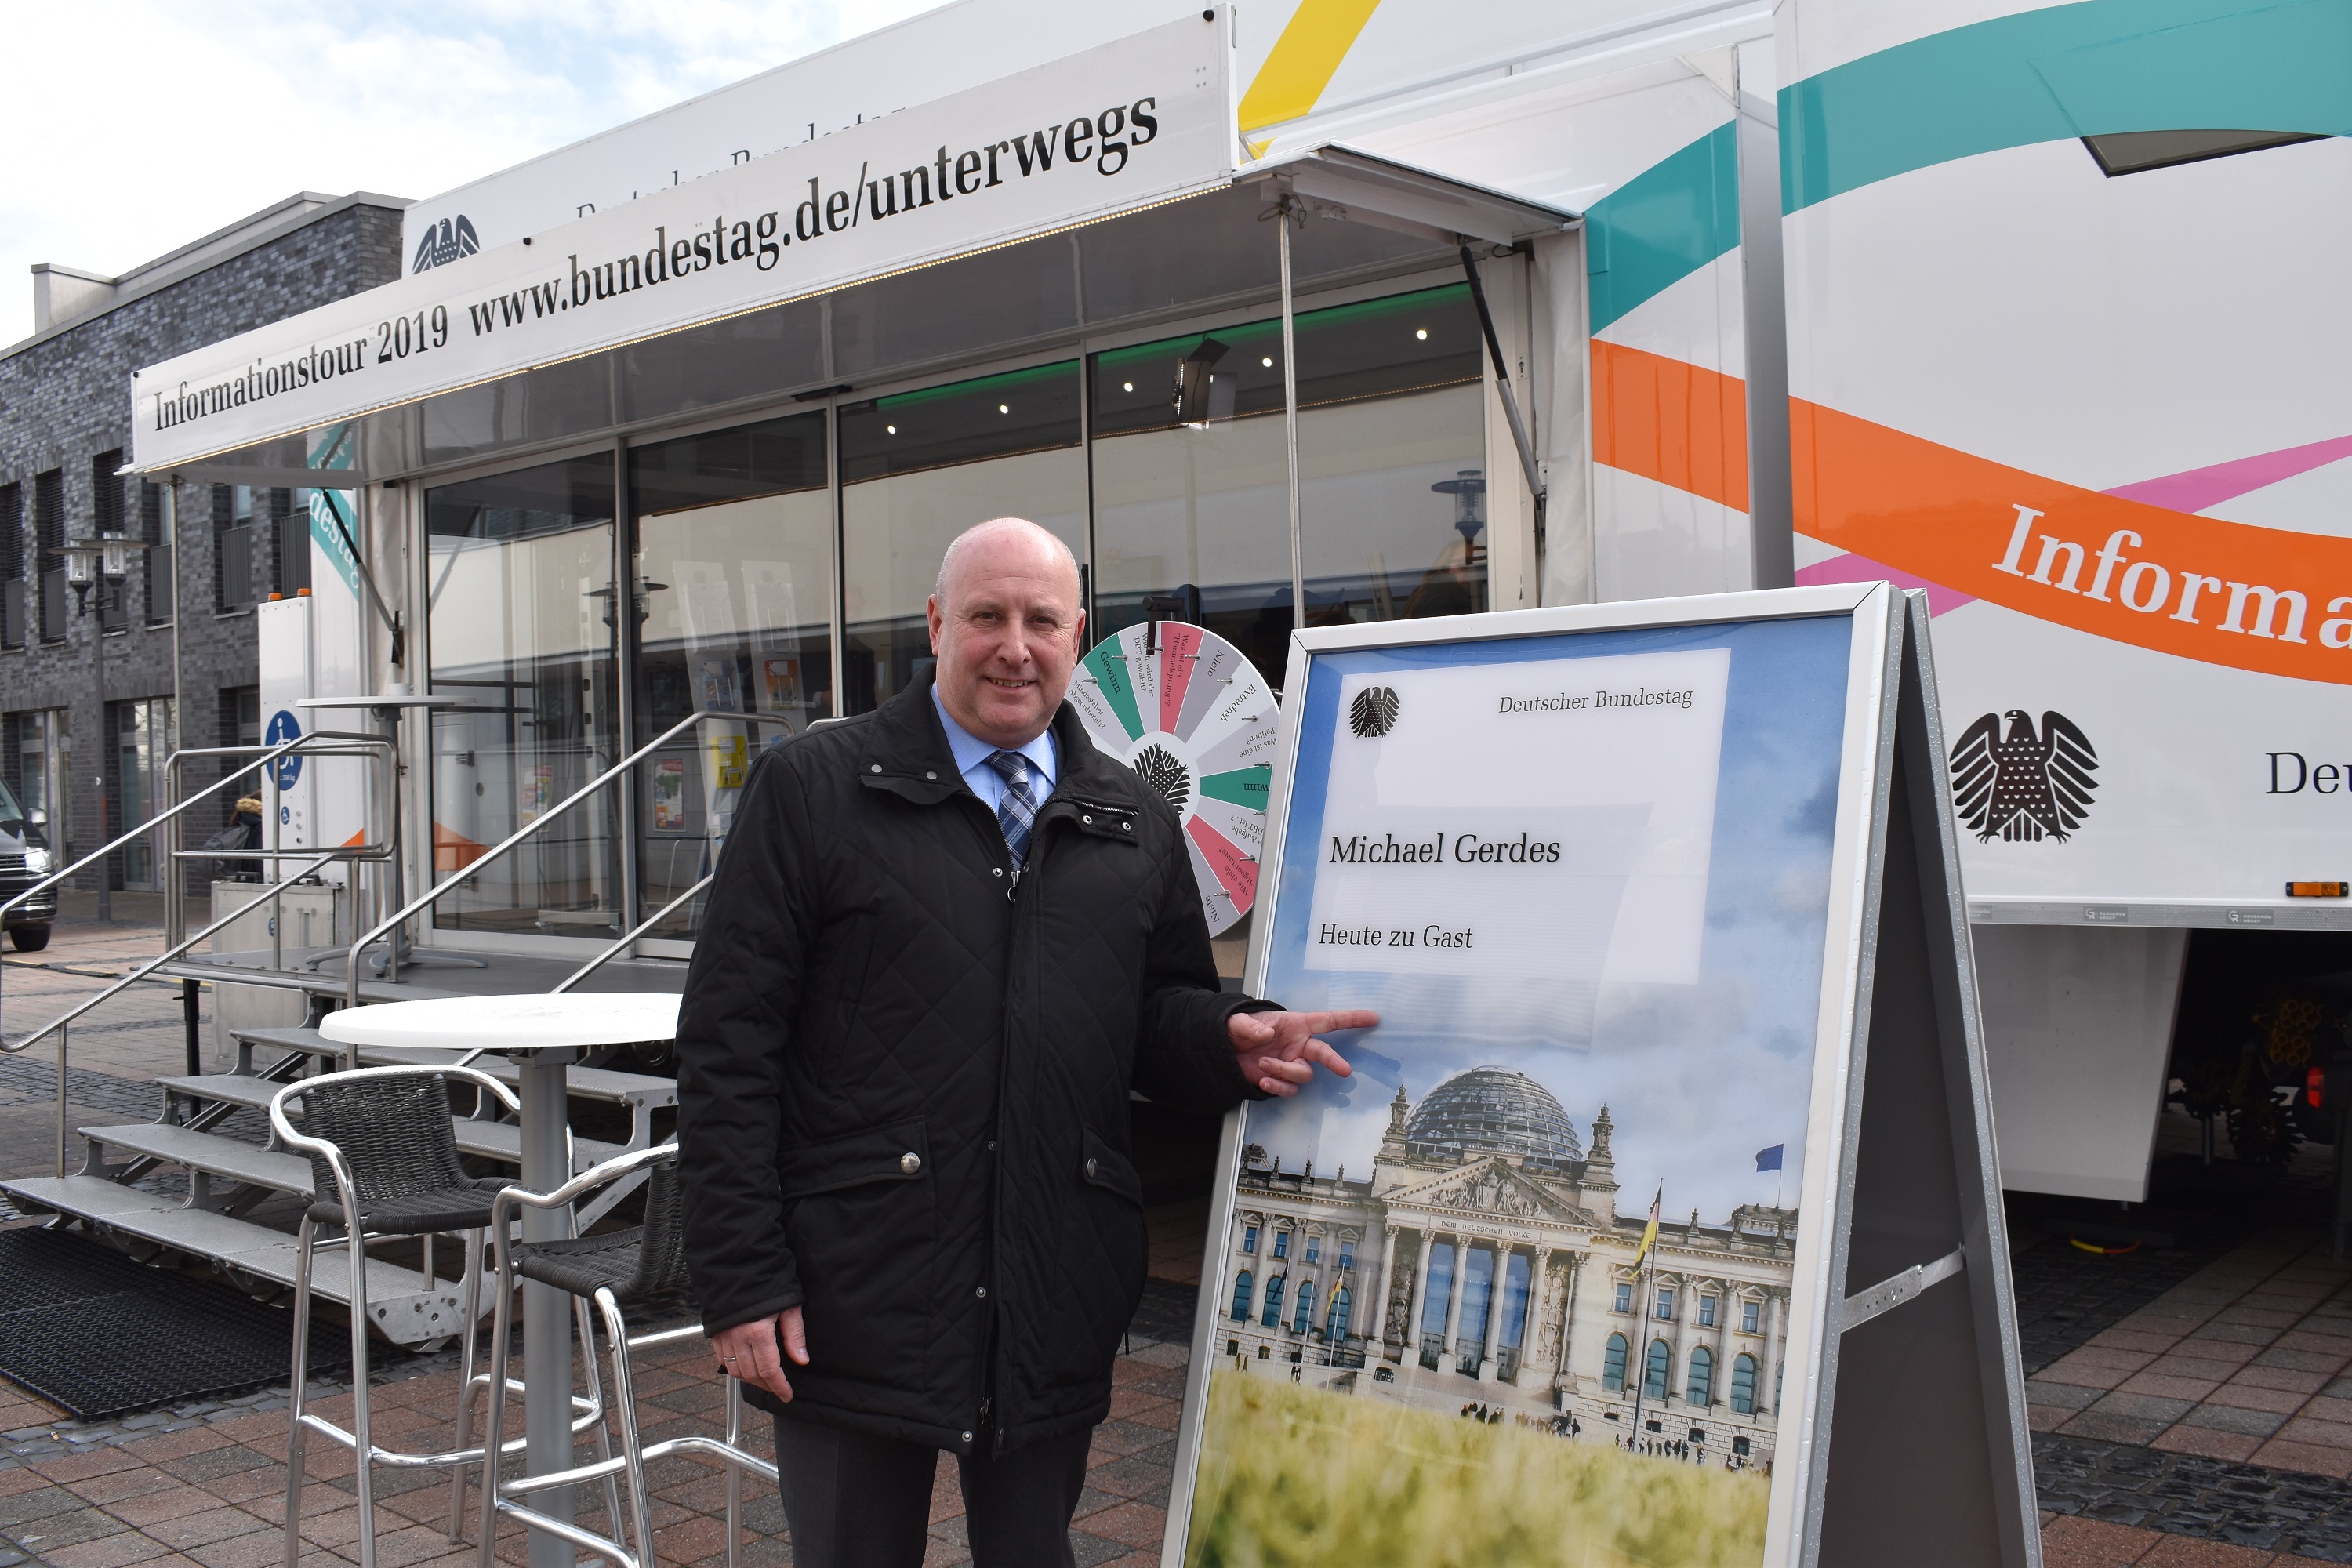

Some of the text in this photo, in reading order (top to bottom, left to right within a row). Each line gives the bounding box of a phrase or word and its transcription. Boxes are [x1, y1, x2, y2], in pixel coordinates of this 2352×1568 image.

[154, 337, 367, 431] Informationstour
[377, 304, 448, 365] 2019
[469, 96, 1160, 338] www.bundestag.de/unterwegs
[1100, 652, 1120, 694] Gewinn
[1136, 657, 1147, 691] gewählt?
[1207, 650, 1225, 677] Niete
[1069, 688, 1105, 730] Abgeordnete/r?
[1073, 680, 1104, 715] Mindestalter
[1220, 684, 1257, 721] Extradreh
[1498, 688, 1693, 713] Deutscher Bundestag
[1239, 737, 1276, 757] Was ist eine
[1247, 727, 1276, 745] Petition?
[1243, 783, 1269, 794] winn
[1231, 825, 1257, 843] Aufgabe
[1329, 832, 1560, 863] Michael Gerdes
[1218, 847, 1255, 887] Abgeordnete?
[1225, 866, 1249, 896] Wie viele
[1205, 895, 1220, 924] Niete
[1318, 923, 1473, 949] Heute zu Gast
[1462, 1224, 1503, 1235] DEUTSCHEN
